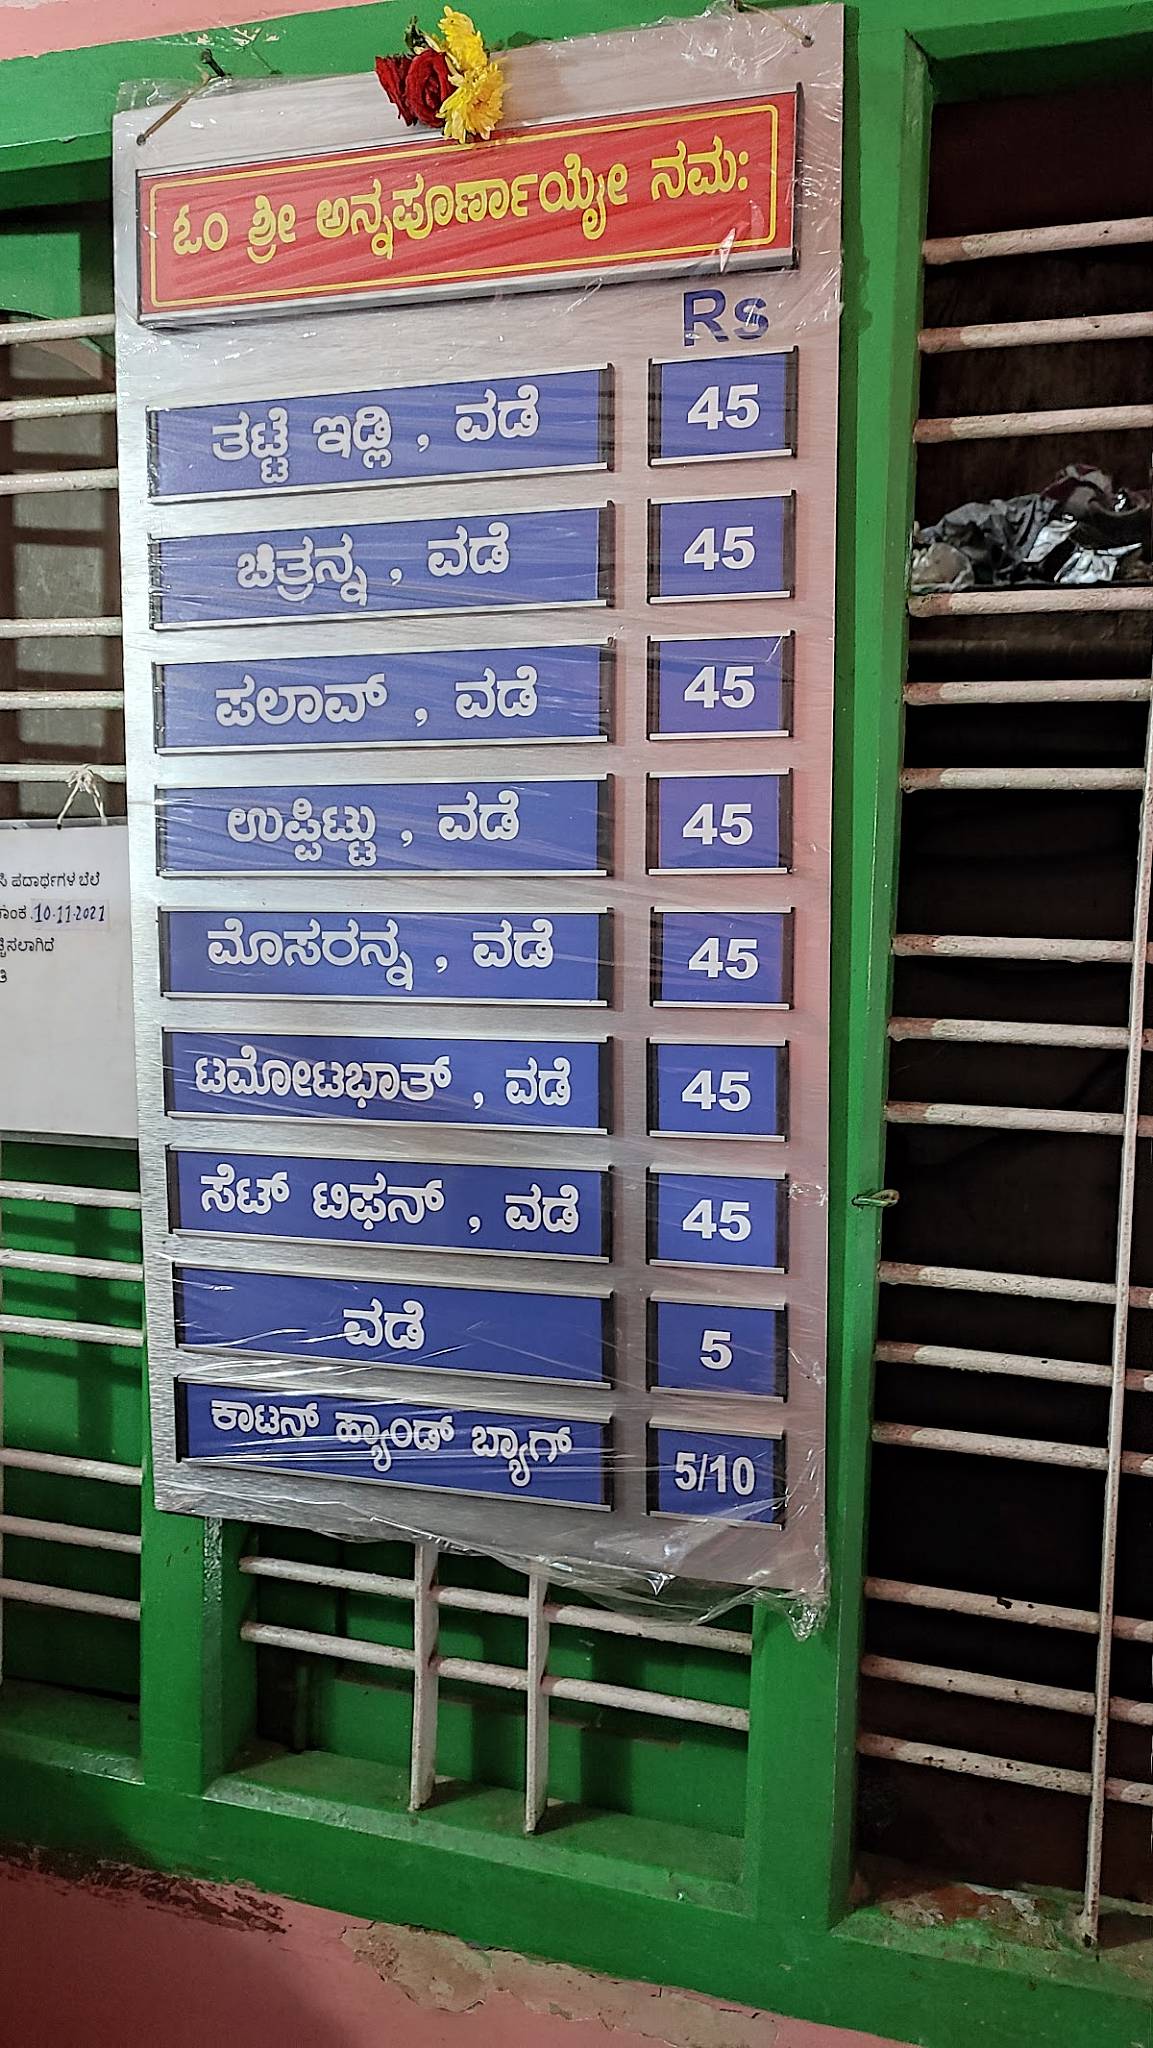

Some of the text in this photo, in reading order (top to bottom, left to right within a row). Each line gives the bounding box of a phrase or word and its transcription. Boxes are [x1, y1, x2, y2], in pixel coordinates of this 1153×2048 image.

[172, 203, 229, 256] ಓಂ
[246, 194, 297, 265] ಶ್ರೀ
[683, 289, 769, 346] Rs
[687, 383, 760, 431] 45
[211, 407, 289, 484] ತಟ್ಟೆ
[312, 405, 392, 469] ಇಡ್ಲಿ
[455, 383, 539, 442] ವಡೆ
[237, 532, 368, 607] ಚಿತ್ರನ್ನ
[427, 521, 511, 577] ವಡೆ
[683, 526, 756, 571] 45
[215, 673, 388, 727] ಪಲಾವ್
[455, 665, 538, 719] ವಡೆ
[684, 665, 755, 709] 45
[227, 797, 377, 867] ಉಪ್ಪಿಟ್ಟು
[437, 789, 520, 841] ವಡೆ
[682, 803, 753, 846] 45
[78, 871, 101, 887] ಬೆಲೆ
[33, 902, 106, 924] 10.11.2021
[207, 918, 414, 991] ಮೊಸರನ್ನ
[472, 918, 554, 968] ವಡೆ
[688, 937, 759, 980] 45
[505, 1057, 571, 1106] ವಡೆ
[681, 1070, 751, 1112] 45
[200, 1163, 290, 1215] ಸೆಟ್
[312, 1172, 445, 1231] ಟಿಫನ್
[505, 1183, 579, 1233] ವಡೆ
[682, 1199, 751, 1242] 45
[343, 1298, 425, 1350] ವಡೆ
[700, 1330, 733, 1370] 5
[210, 1400, 572, 1487] ಕಾಟನ್ ಹ್ಯಾಂಡ್ ಬ್ಯಾಗ್
[675, 1452, 755, 1495] 5/10
